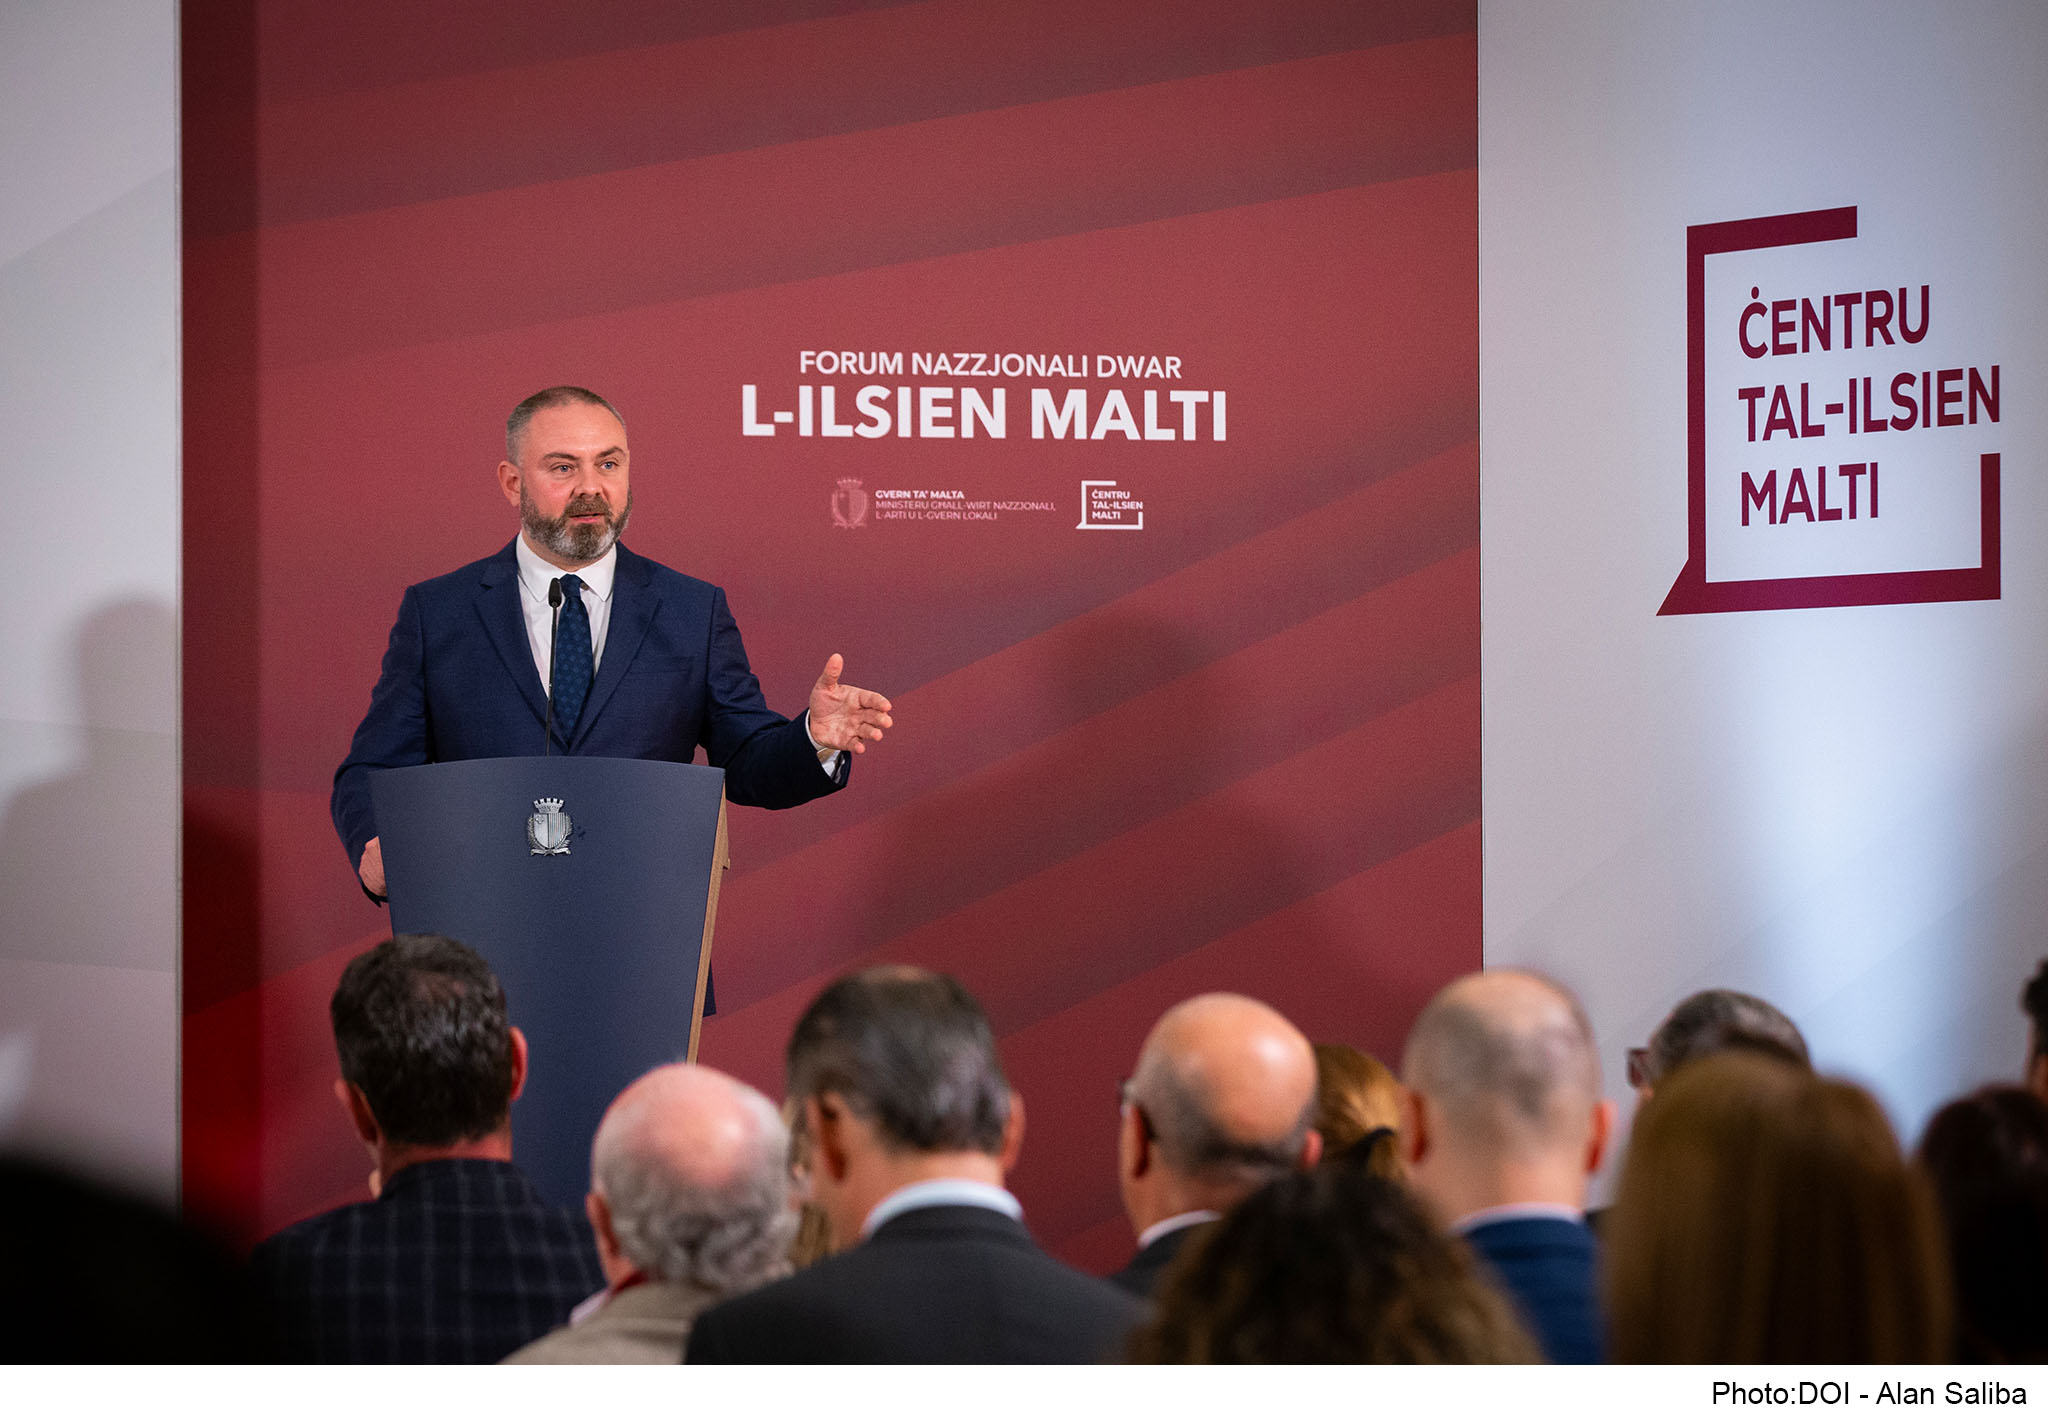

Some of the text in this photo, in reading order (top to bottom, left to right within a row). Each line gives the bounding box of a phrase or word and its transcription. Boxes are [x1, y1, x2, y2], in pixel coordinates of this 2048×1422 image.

[1738, 285, 1930, 360] ĊENTRU
[800, 350, 1182, 379] FORUM NAZZJONALI DWAR
[742, 384, 1227, 442] L-ILSIEN MALTI
[1738, 365, 2000, 443] TAL-ILSIEN
[875, 490, 911, 499] GVERN
[930, 490, 965, 500] MALTA
[1741, 461, 1879, 527] MALTI
[875, 501, 929, 510] MINISTERU
[1092, 500, 1143, 511] TAL-ILSIEN
[1092, 510, 1121, 520] MALTI
[908, 511, 916, 520] U
[918, 511, 960, 521] L-GVERN
[962, 511, 997, 521] LOKALI
